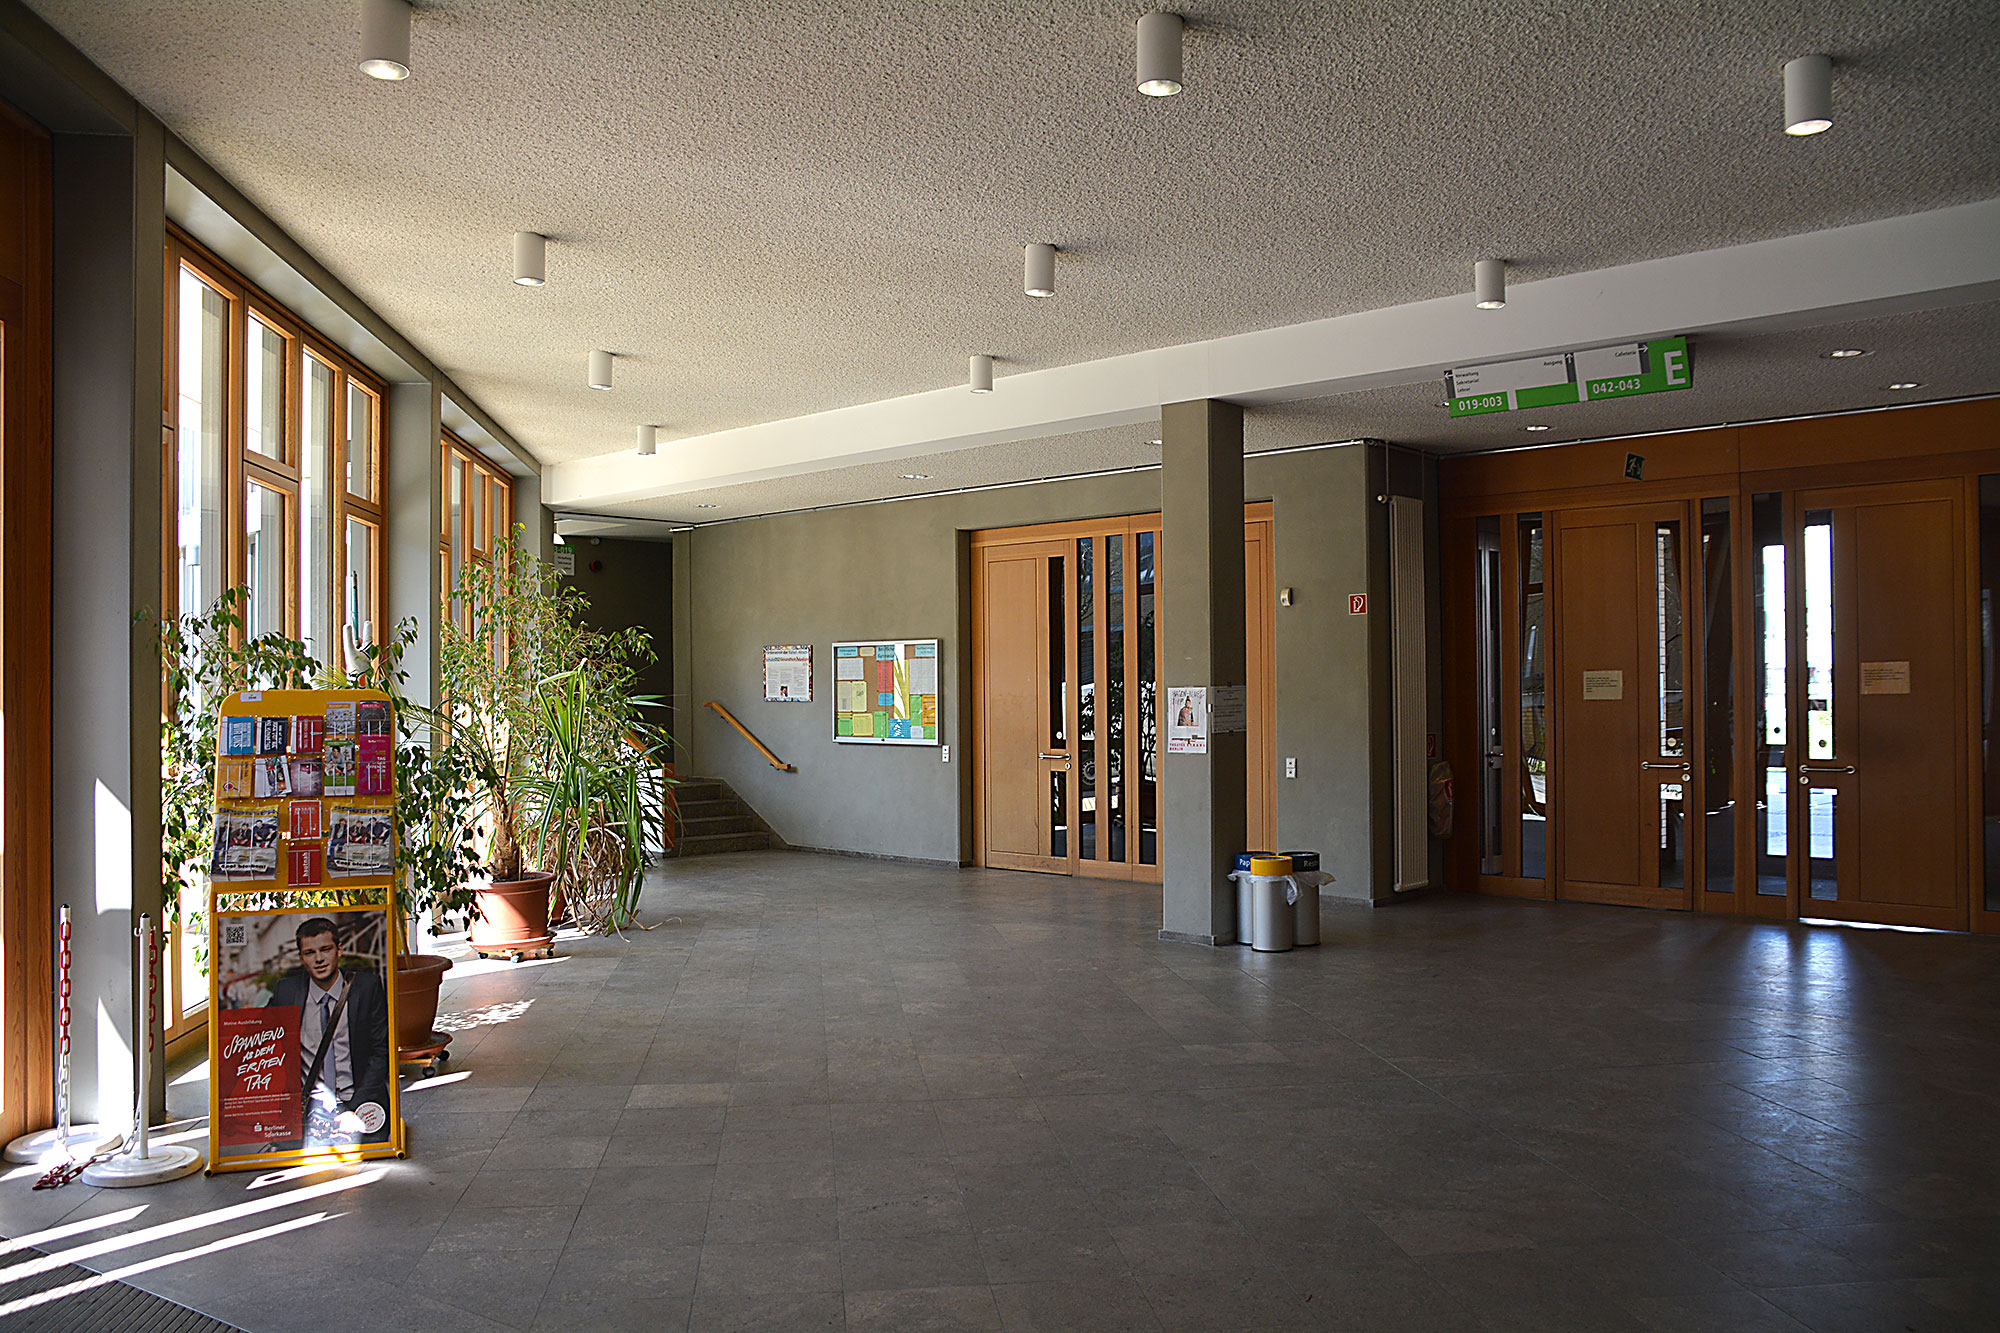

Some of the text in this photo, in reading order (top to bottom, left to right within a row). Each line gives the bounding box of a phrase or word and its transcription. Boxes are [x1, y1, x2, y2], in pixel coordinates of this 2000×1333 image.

[1663, 350, 1686, 386] E
[1592, 378, 1641, 394] 042-043
[1458, 396, 1503, 411] 019-003
[1239, 858, 1251, 867] Pap
[223, 1026, 285, 1060] SPANNEND
[242, 1044, 276, 1062] AB DEM
[236, 1052, 286, 1076] ERSTEN
[243, 1073, 273, 1092] TAG
